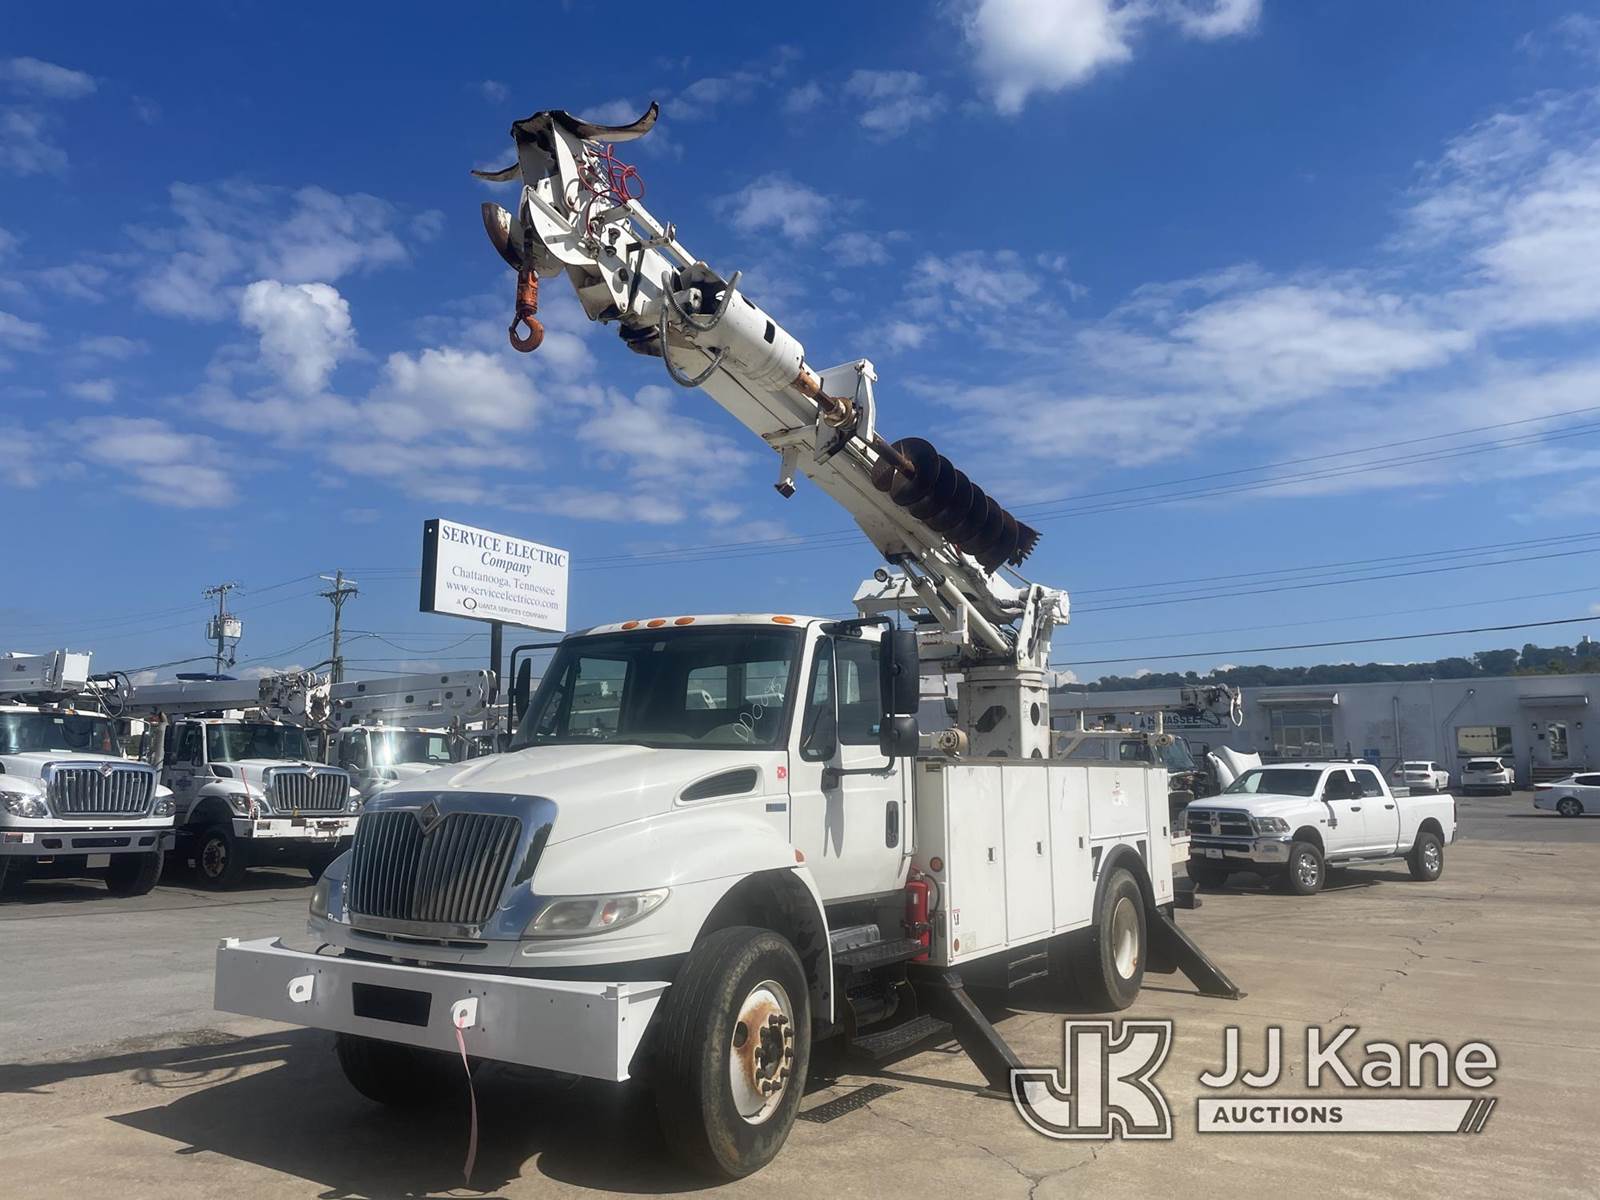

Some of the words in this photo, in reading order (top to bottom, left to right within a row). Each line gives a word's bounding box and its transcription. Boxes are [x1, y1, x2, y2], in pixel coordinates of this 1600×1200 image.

[442, 525, 501, 552] SERVICE
[506, 541, 566, 567] ELECTRIC
[481, 551, 532, 576] Company
[446, 581, 559, 609] www.serviceelectricco.com
[452, 566, 511, 588] Chattanooga,
[513, 578, 555, 596] Tennessee
[498, 605, 521, 616] SERVICES
[522, 610, 548, 620] COMPANY
